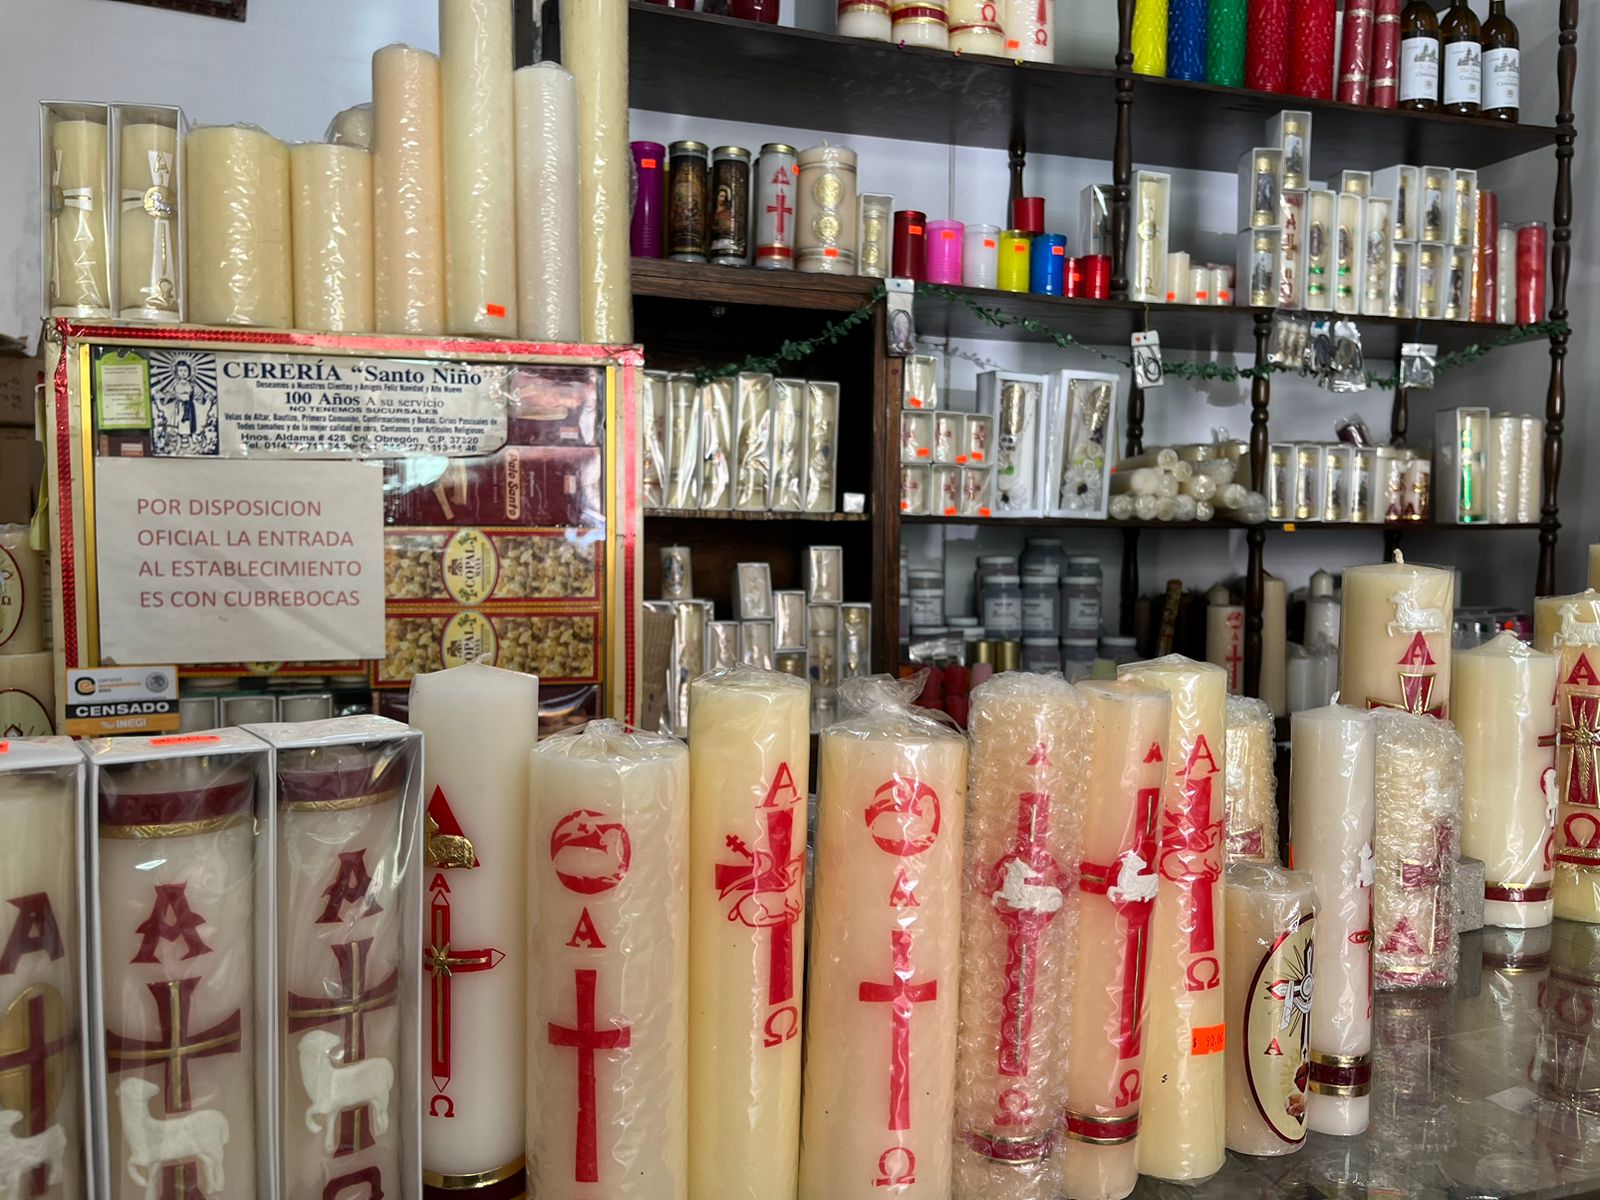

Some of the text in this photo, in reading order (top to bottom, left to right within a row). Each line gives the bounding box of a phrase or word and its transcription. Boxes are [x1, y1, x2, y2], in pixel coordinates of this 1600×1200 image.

[223, 359, 343, 381] CERERÍA
[256, 380, 289, 389] Deseamos
[297, 382, 326, 390] Nuestros
[327, 382, 353, 391] Clientes
[360, 383, 383, 393] Amigos
[384, 384, 398, 392] Feliz
[400, 385, 424, 393] Navidad
[431, 385, 442, 393] Año
[285, 391, 444, 408] 100 Años A su servicio
[225, 412, 243, 421] Velas
[244, 412, 252, 420] de
[253, 413, 271, 422] Altar,
[302, 413, 326, 422] Primera
[363, 415, 410, 424] Confirmaciones
[440, 417, 457, 425] Cirios
[459, 417, 488, 426] Pascuales
[310, 406, 362, 414] TENEMOS
[366, 407, 439, 415] SUCURSALES
[237, 422, 255, 430] Todos
[257, 422, 285, 431] tamaños
[292, 423, 300, 431] de
[302, 423, 308, 431] la
[309, 423, 327, 432] mejor
[330, 423, 352, 432] calidad
[380, 425, 411, 433] Contamos
[454, 426, 485, 436] Religiosos
[241, 433, 271, 441] Hnos.
[275, 433, 316, 442] Aldama
[318, 433, 325, 441] #
[327, 433, 346, 442] 428
[374, 435, 419, 445] Obregón
[428, 436, 446, 444] C.P.
[507, 452, 519, 517] Palo Santo
[137, 498, 322, 517] POR DISPOSICION
[137, 529, 354, 547] OFICIAL LA ENTRADA
[138, 560, 362, 577] AL ESTABLECIMIENTO
[464, 546, 476, 588] COPAL
[140, 590, 361, 608] ES CON CUBREBOCAS
[464, 627, 476, 662] OPAL
[1396, 630, 1438, 666] A
[1562, 651, 1600, 687] A
[75, 702, 170, 718] CENSADO
[116, 718, 147, 730] INEGI
[1175, 734, 1221, 777] A
[755, 762, 802, 809] A
[1562, 811, 1600, 850] Ω
[314, 848, 384, 925] A
[428, 873, 452, 894] A
[0, 891, 66, 976] A
[129, 880, 214, 965] A
[565, 907, 607, 949] A
[1183, 956, 1221, 992] Ω
[763, 1005, 800, 1049] Ω
[1263, 1036, 1284, 1057] A
[1115, 1068, 1142, 1109] Ω
[429, 1095, 456, 1119] Ω
[871, 1146, 917, 1189] Ω
